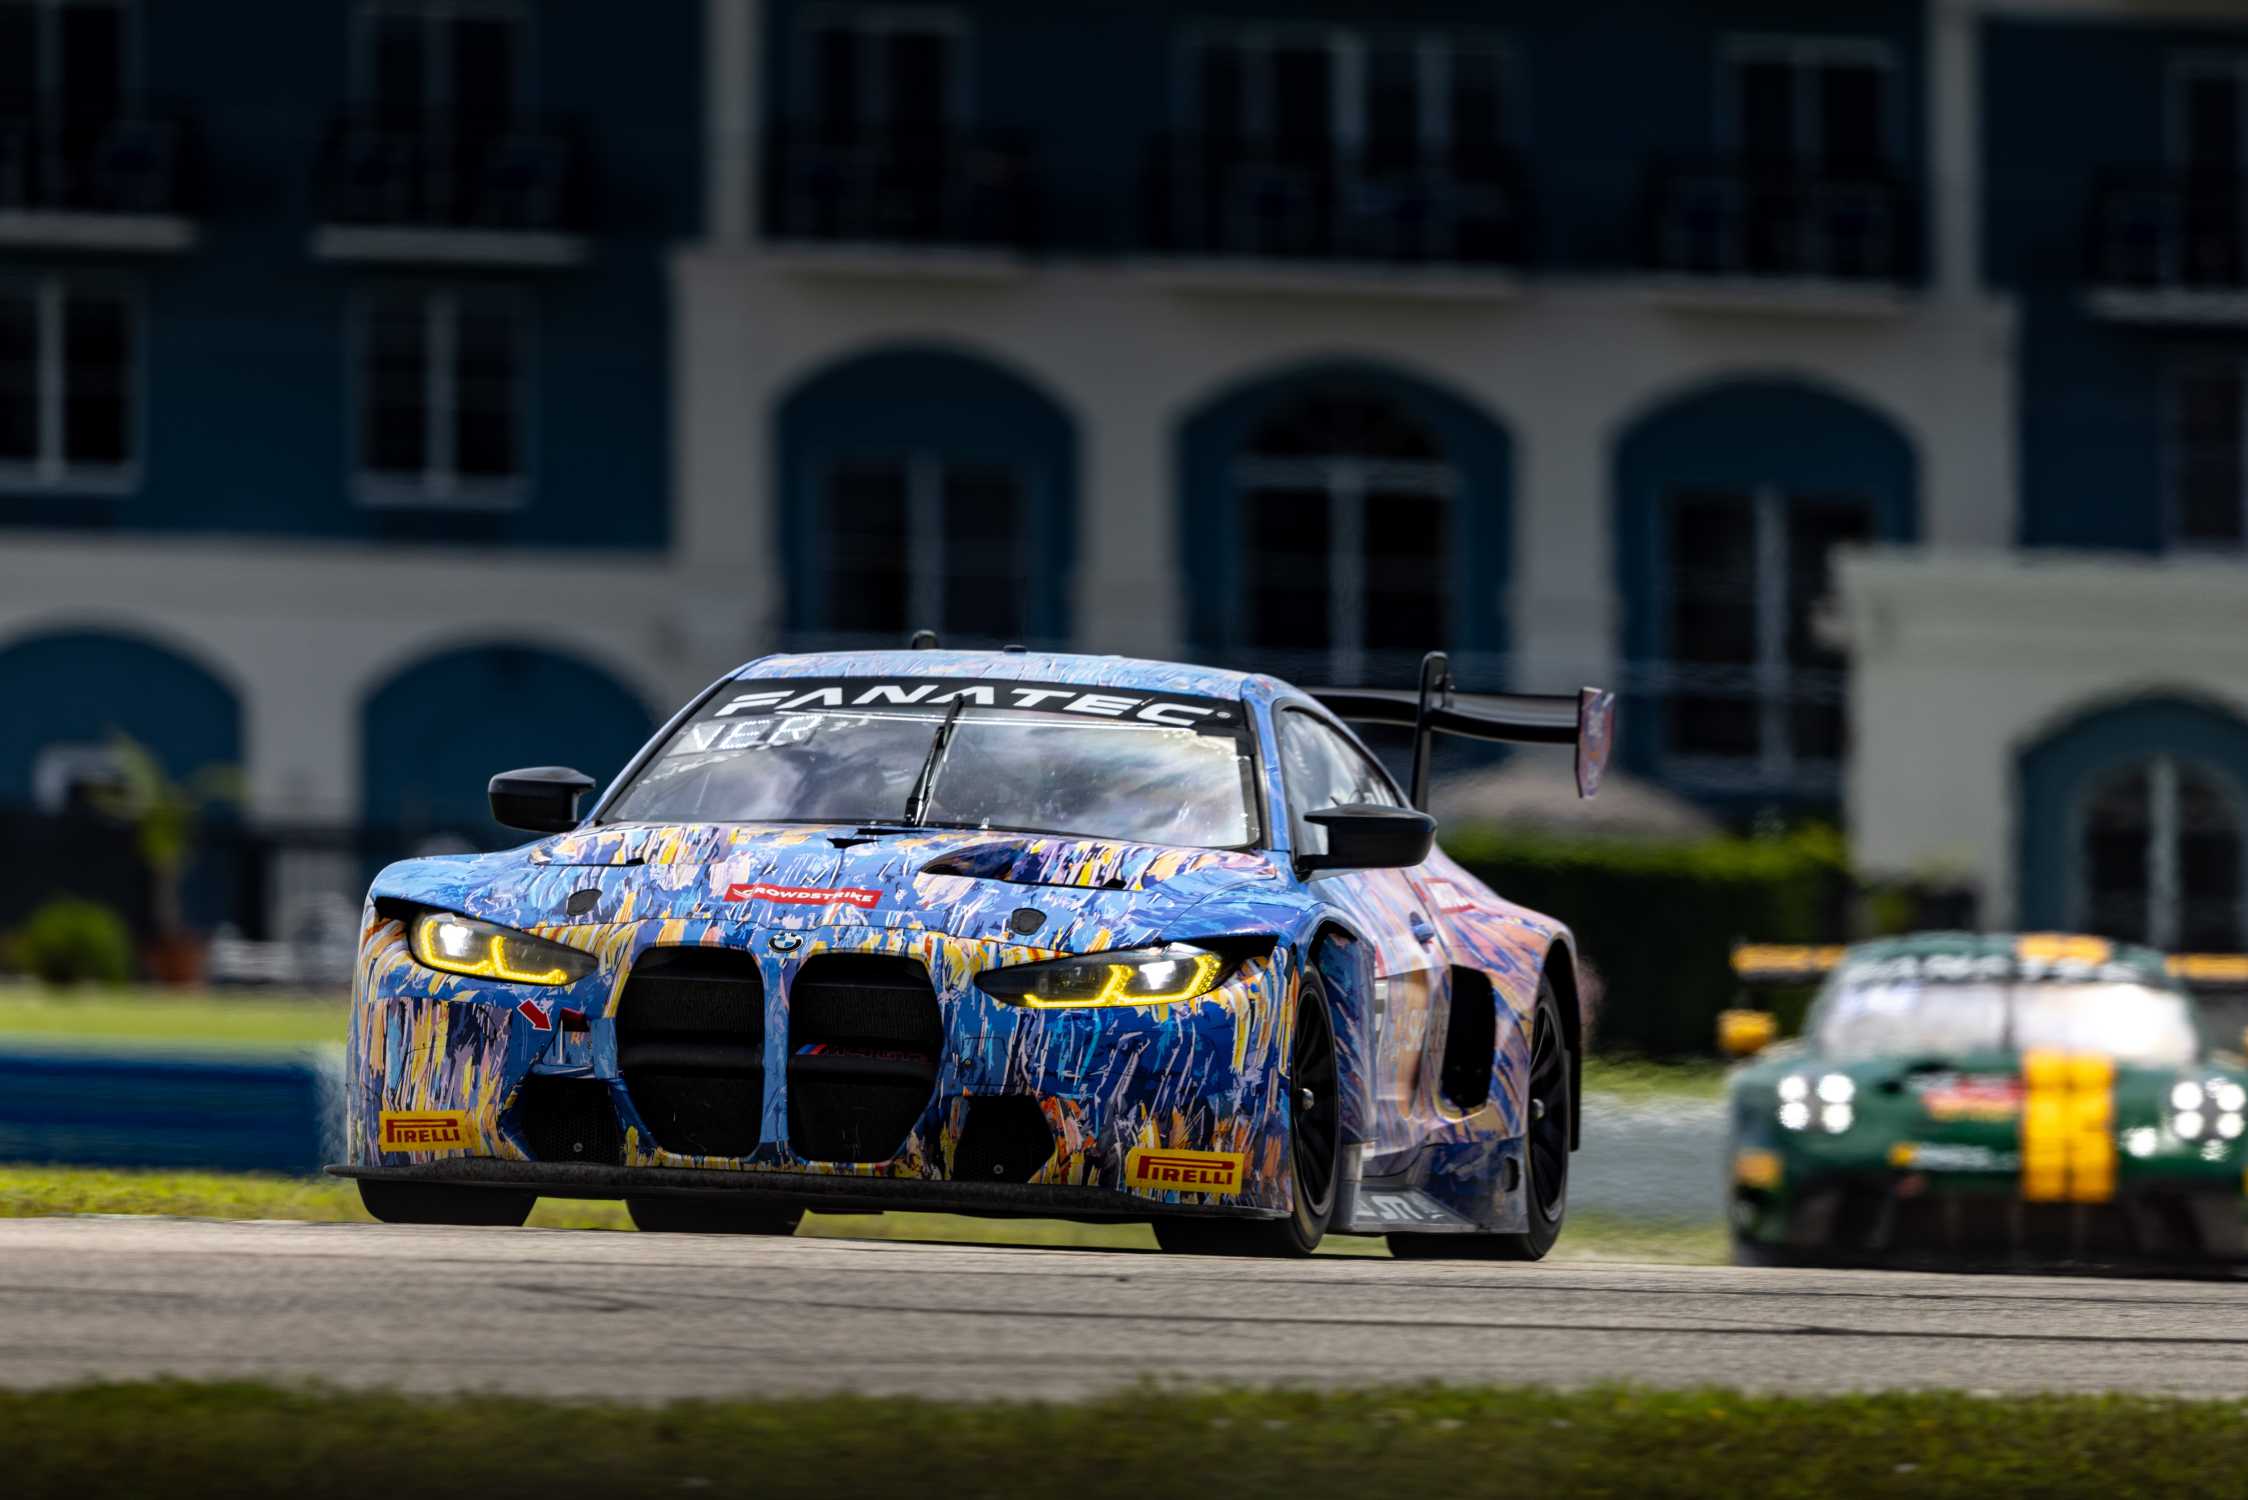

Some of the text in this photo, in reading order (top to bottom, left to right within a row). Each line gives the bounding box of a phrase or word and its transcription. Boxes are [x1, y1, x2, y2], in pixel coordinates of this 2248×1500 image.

[714, 684, 1214, 727] FANATEC
[741, 886, 874, 903] CROWDSTRIKE
[386, 1118, 460, 1143] PIRELLI
[1136, 1155, 1235, 1185] PIRELLI
